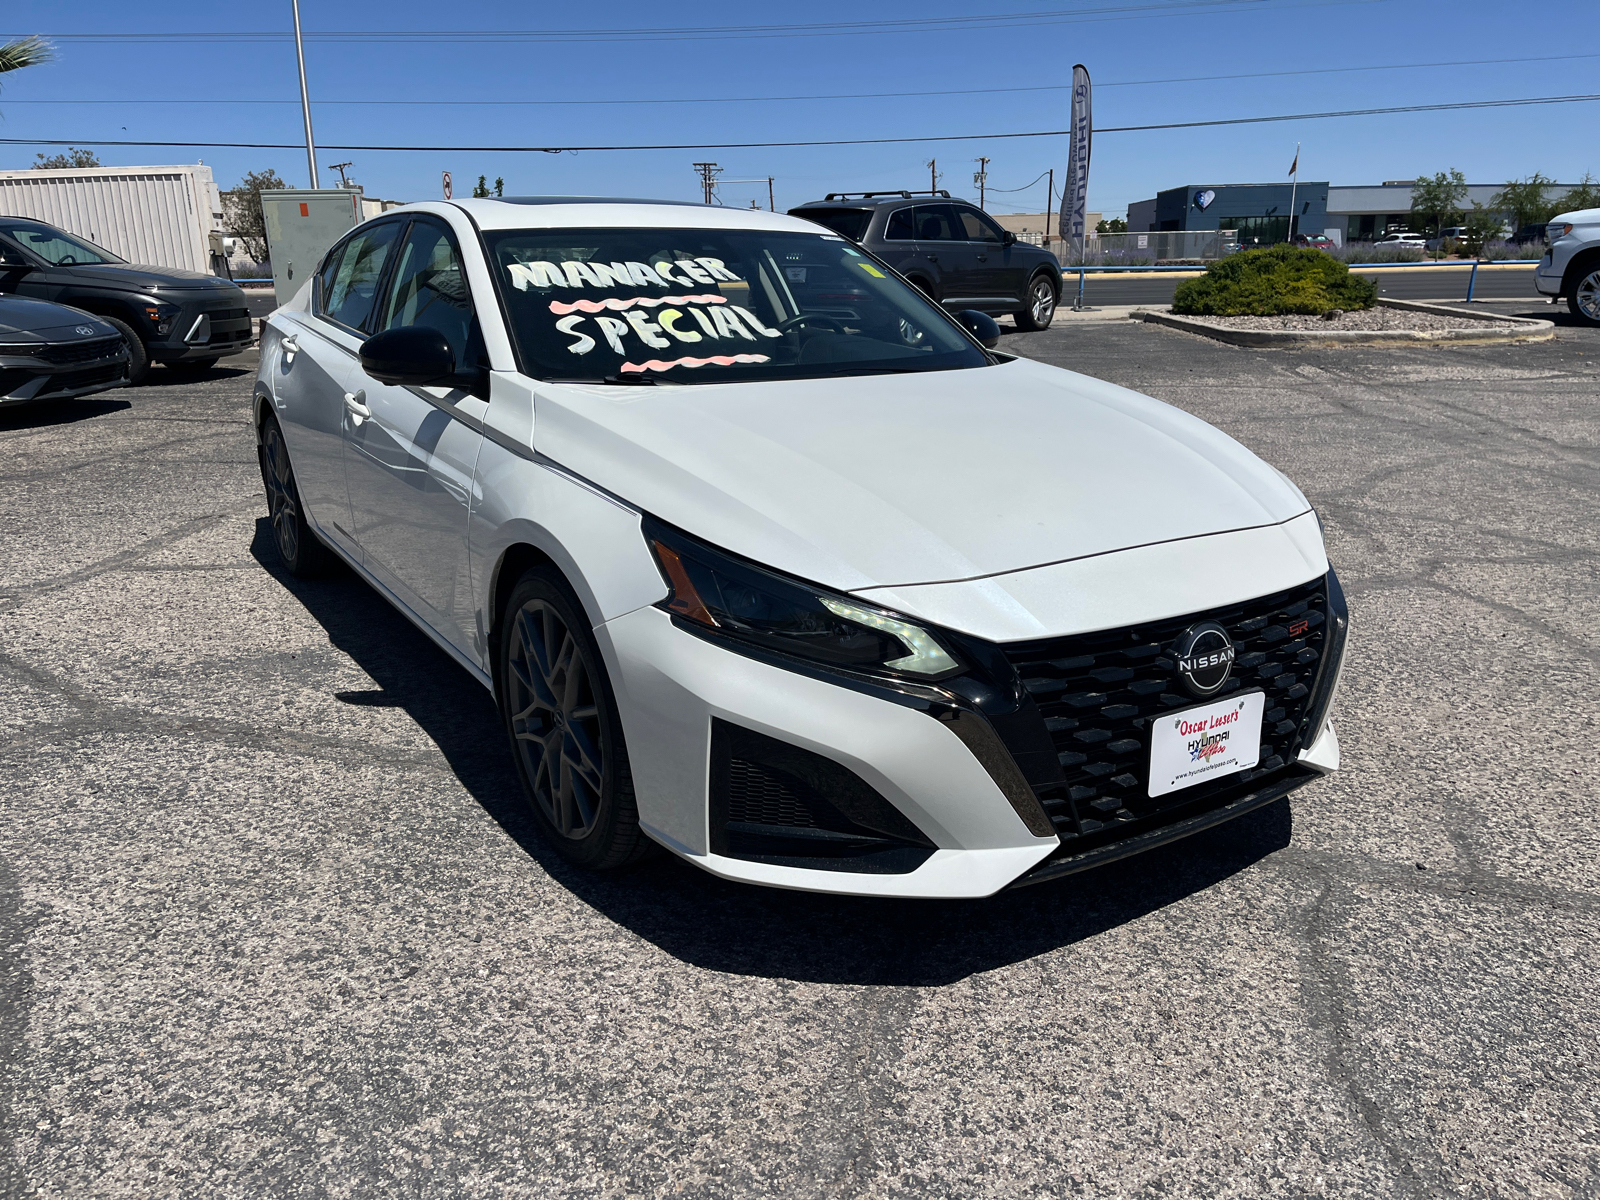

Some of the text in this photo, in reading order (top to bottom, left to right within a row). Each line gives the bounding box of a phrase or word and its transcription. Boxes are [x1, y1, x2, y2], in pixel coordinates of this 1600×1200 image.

[507, 257, 742, 291] MANAGER
[555, 305, 783, 356] SPECIAL
[1289, 620, 1308, 637] SR
[1179, 648, 1235, 671] NISSAN
[1180, 709, 1239, 736] Oscar Leeser's
[1187, 730, 1230, 751] HYUNDAI
